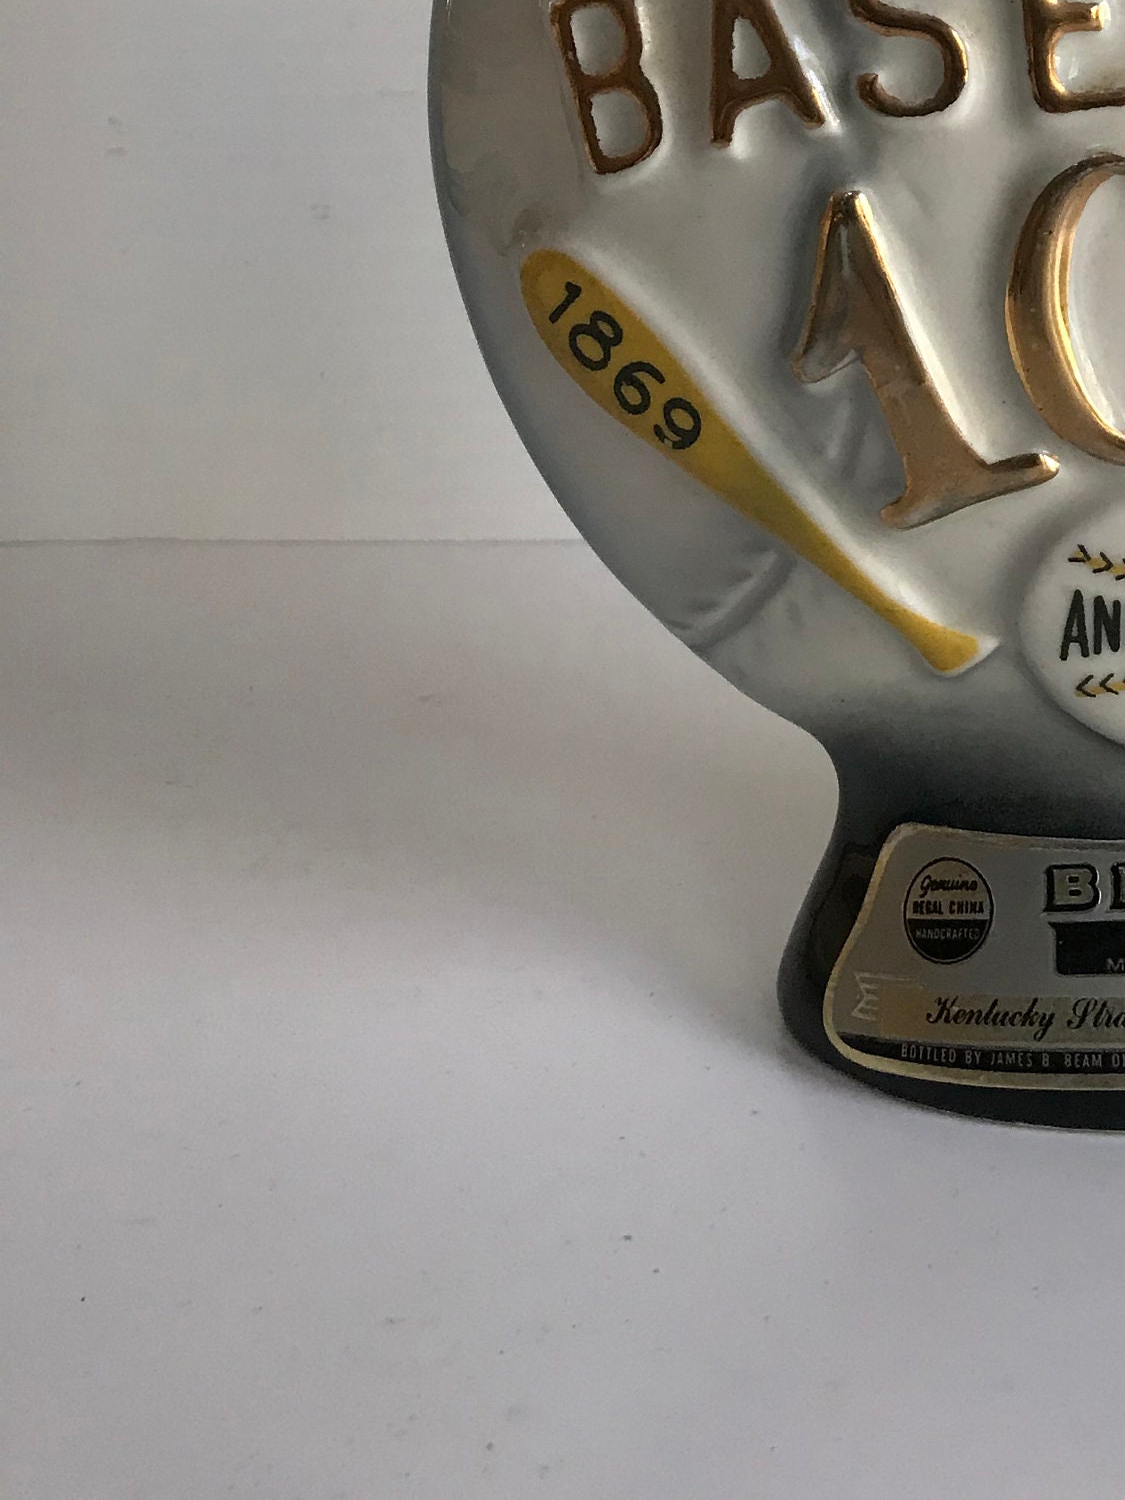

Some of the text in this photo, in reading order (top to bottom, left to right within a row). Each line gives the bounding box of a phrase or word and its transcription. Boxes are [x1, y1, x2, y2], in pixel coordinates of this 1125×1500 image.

[548, 281, 702, 449] 1869
[919, 874, 978, 898] Genuine
[912, 900, 984, 915] REGAL CHINA
[915, 927, 980, 940] HANDCRAFTED
[926, 996, 1056, 1041] Kentucky
[900, 1043, 956, 1063] BOTTLED
[965, 1051, 982, 1065] BY
[990, 1052, 1033, 1068] JAMES
[1064, 1053, 1102, 1068] BEAM
